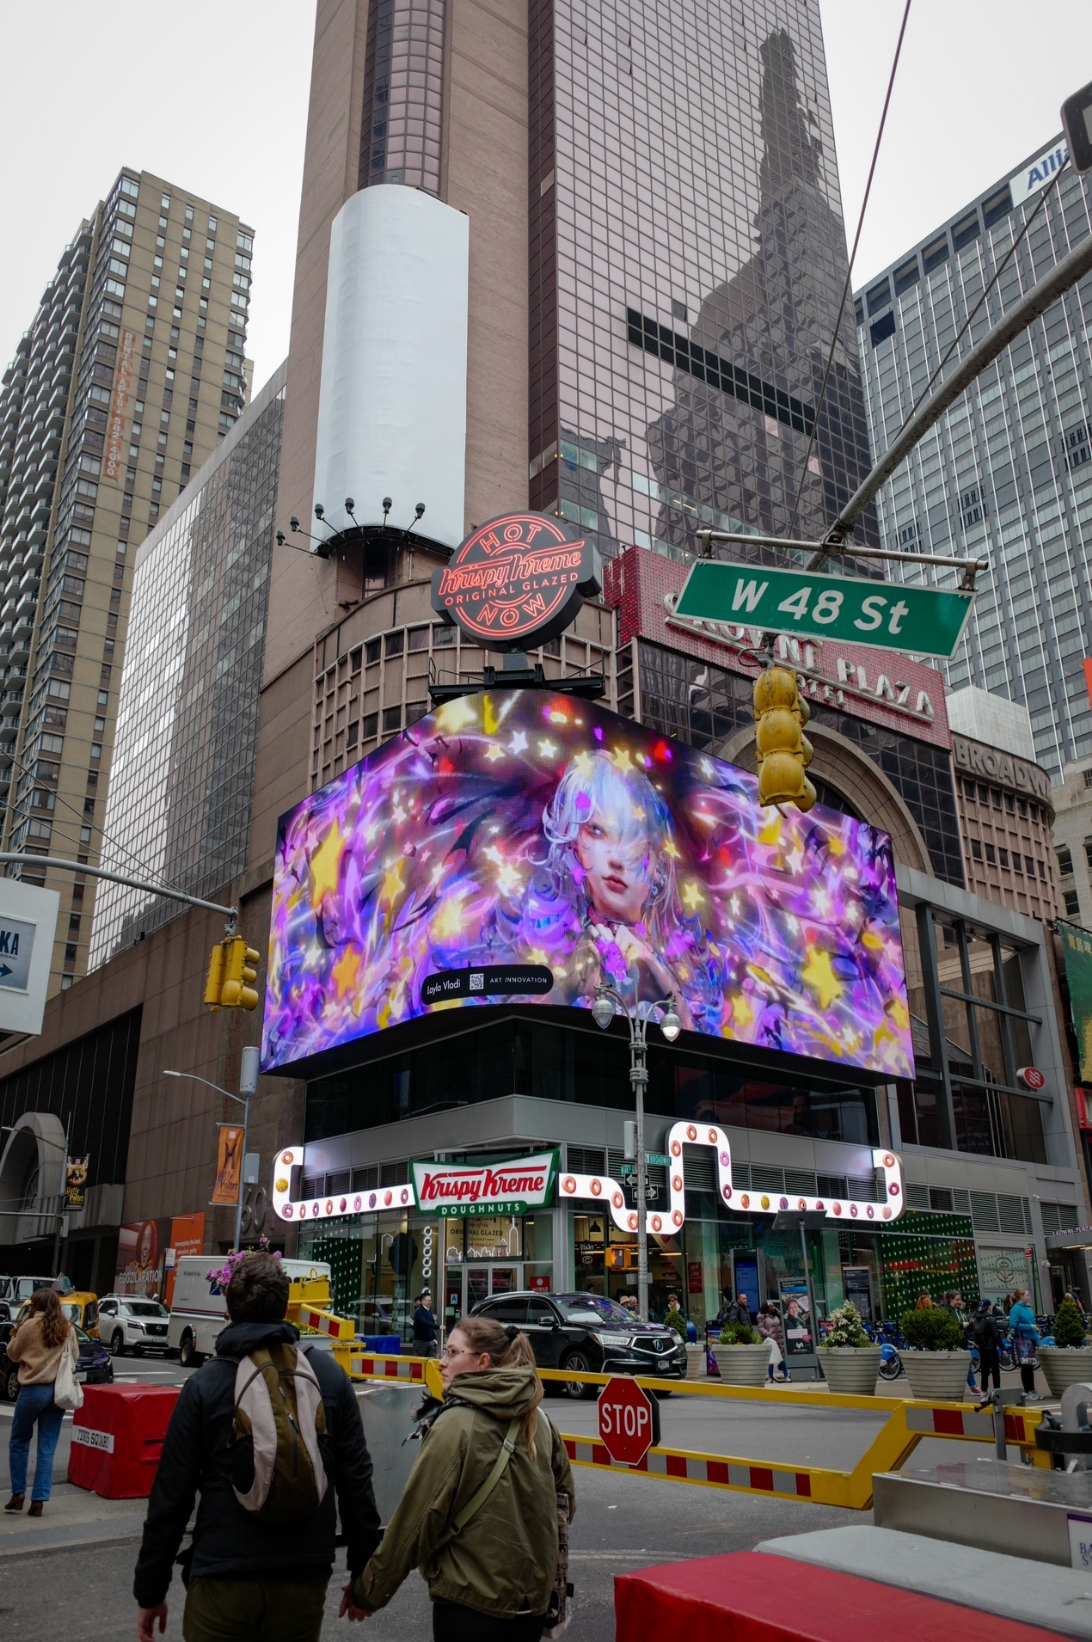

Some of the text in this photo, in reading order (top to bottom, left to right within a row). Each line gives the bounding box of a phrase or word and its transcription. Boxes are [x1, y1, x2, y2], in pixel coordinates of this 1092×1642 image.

[121, 333, 133, 375] RENTAL
[479, 523, 543, 554] HOT
[438, 540, 585, 595] Krispy Kreme
[444, 572, 580, 606] ORIGINAL GLAZED
[476, 593, 546, 627] NOW
[731, 578, 910, 635] W 48 St
[796, 674, 848, 706] OTEL
[836, 656, 935, 717] PLAZA
[504, 976, 547, 984] INNOVATION
[420, 1165, 547, 1202] Krispy Kreme
[441, 1203, 520, 1215] DOUGHNUTS
[601, 1402, 649, 1437] STOP
